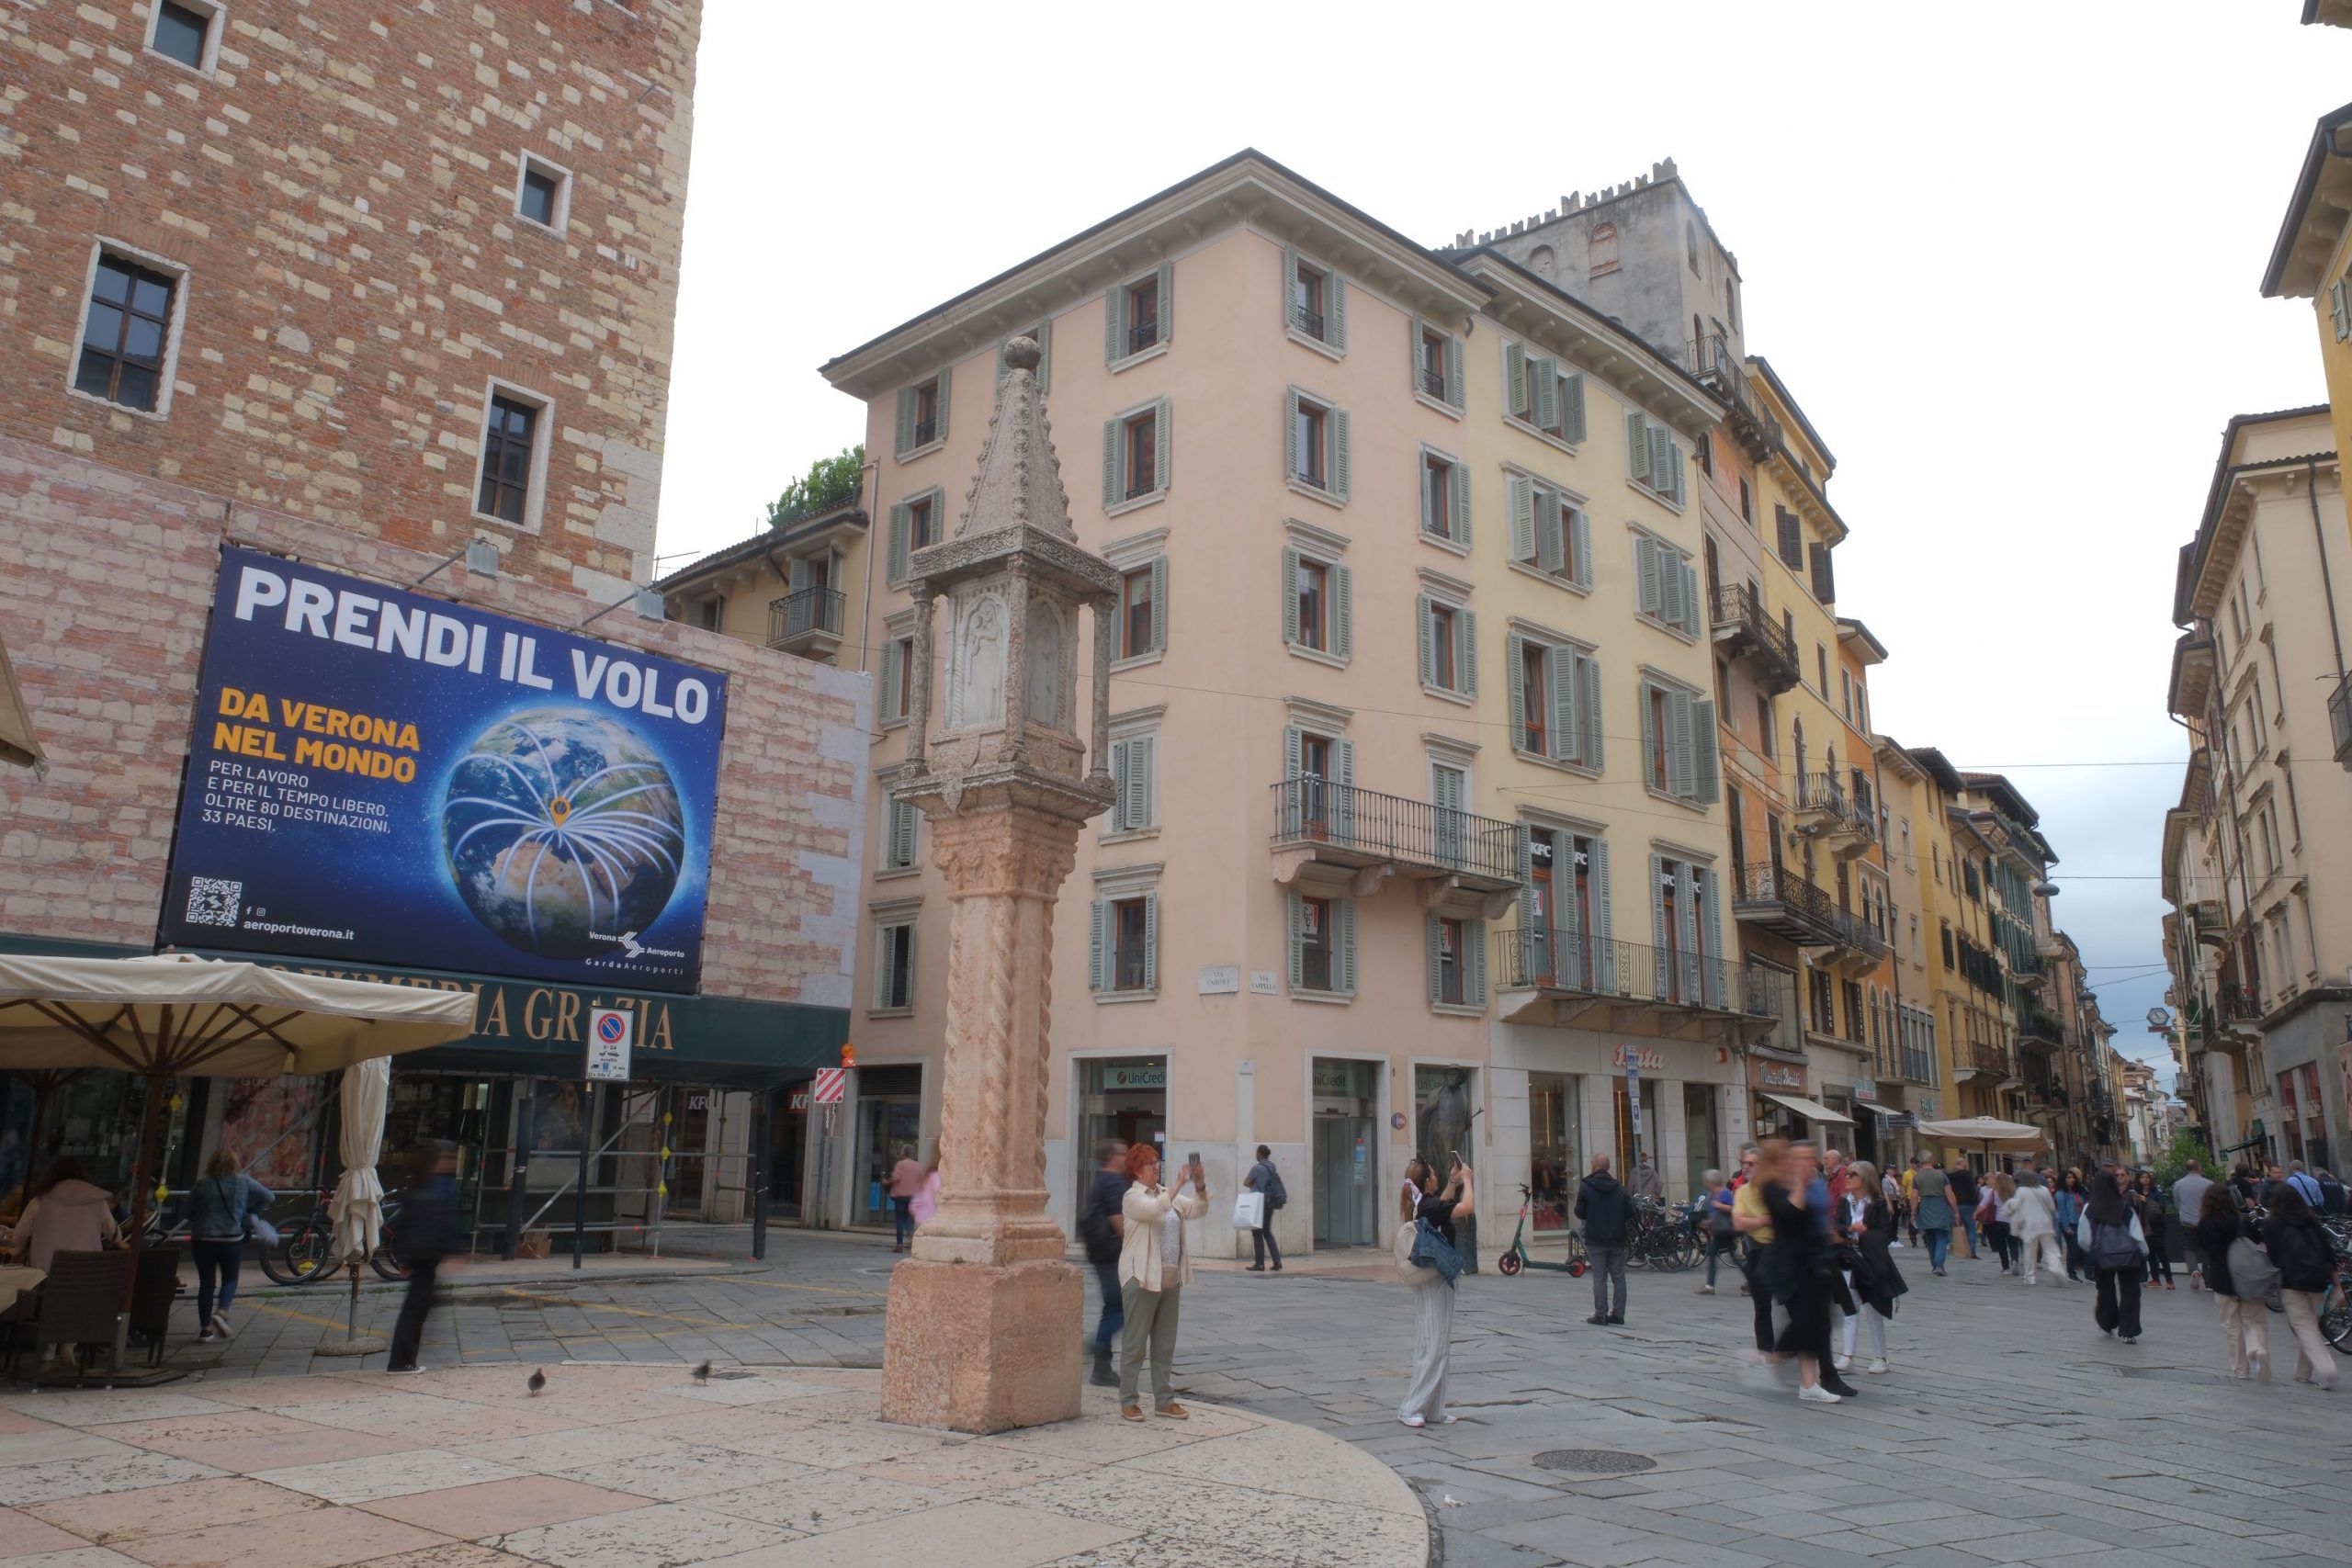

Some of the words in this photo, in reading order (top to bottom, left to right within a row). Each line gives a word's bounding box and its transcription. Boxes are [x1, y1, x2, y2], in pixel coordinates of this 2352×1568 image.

[235, 566, 488, 674] PRENDI
[500, 632, 553, 691] IL
[571, 649, 708, 724] VOLO
[219, 687, 270, 723] DA
[281, 699, 420, 751] VERONA
[213, 722, 286, 761] NEL
[294, 737, 416, 784] MONDO
[209, 760, 242, 777] PER
[246, 766, 309, 788] LAVORO
[205, 793, 257, 813] OLTRE
[260, 803, 279, 817] 80
[283, 805, 390, 835] DESTINAZIONI,
[208, 776, 219, 790] E
[222, 779, 254, 795] PER
[258, 784, 273, 798] IL
[277, 787, 329, 808] TEMPO
[333, 796, 390, 818] LIBERO.
[201, 808, 220, 823] 33
[225, 812, 276, 832] PAESI.
[1531, 841, 1551, 858] KFC
[243, 919, 355, 941] aeroportoverona.it
[589, 931, 616, 942] Verona
[646, 946, 684, 958] Aeroporto
[525, 987, 674, 1050] GRIA
